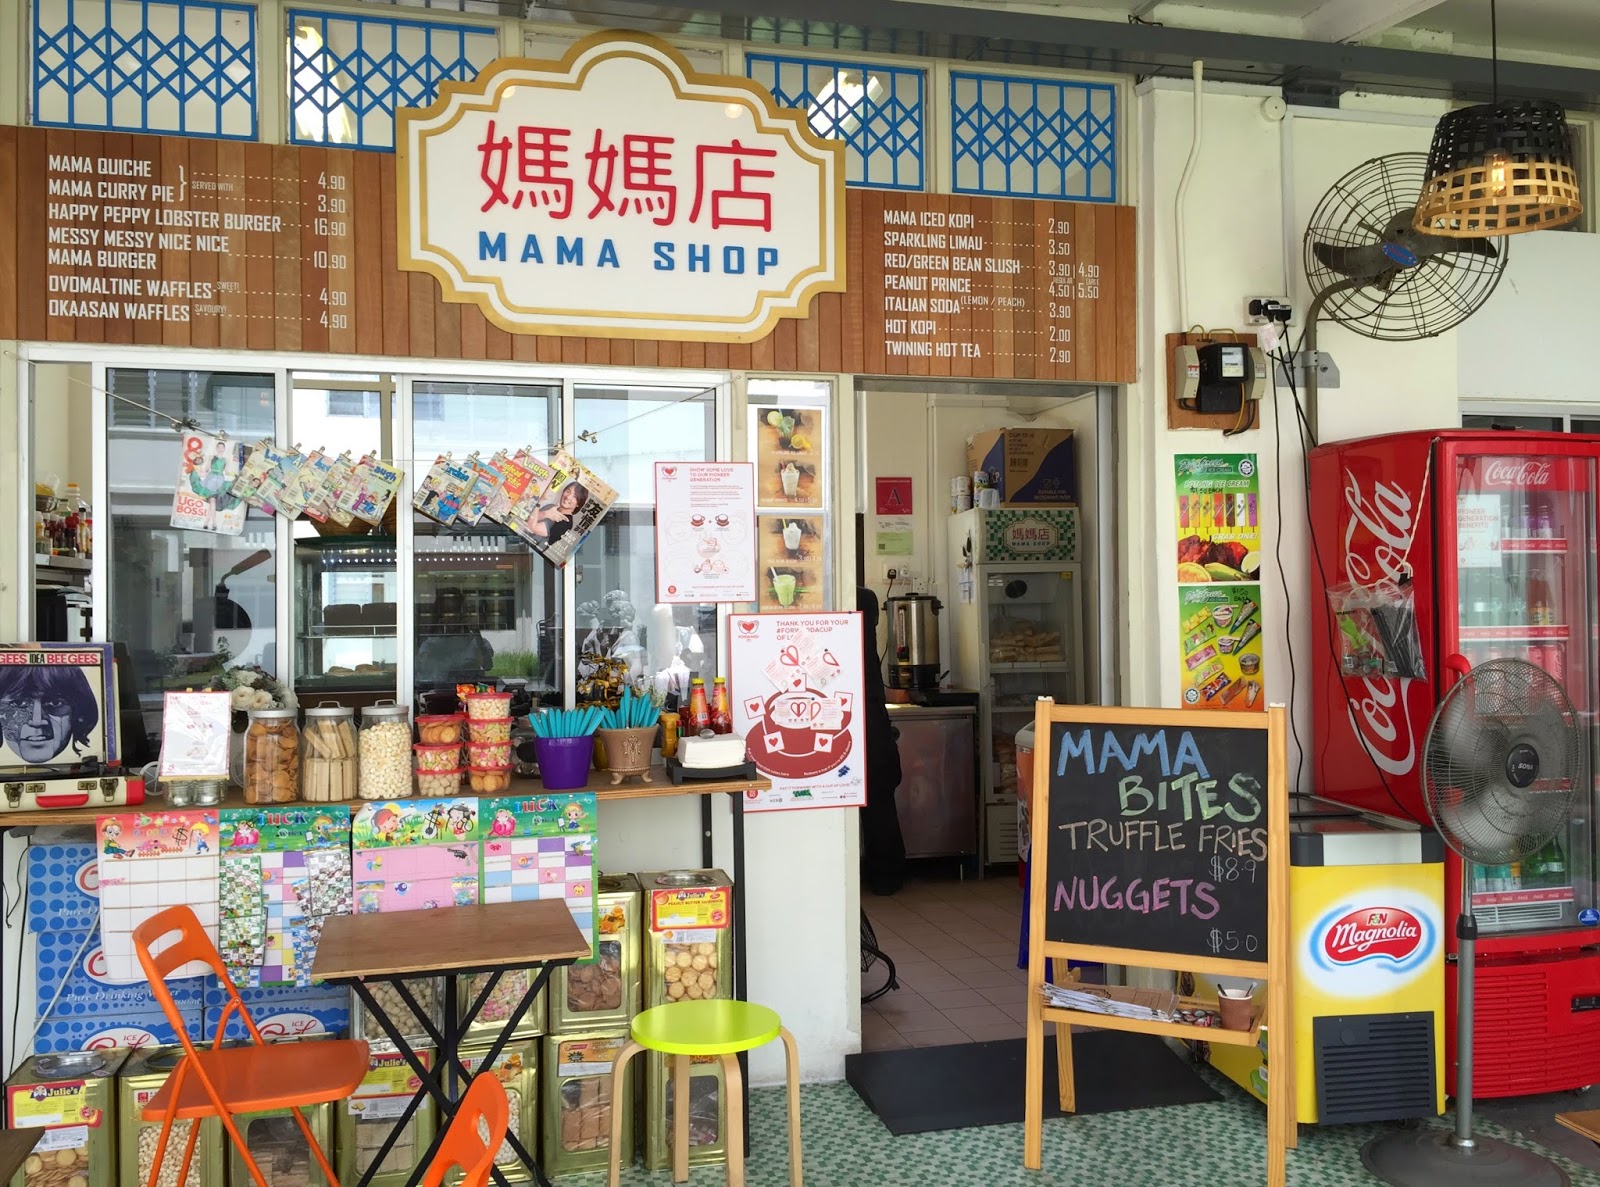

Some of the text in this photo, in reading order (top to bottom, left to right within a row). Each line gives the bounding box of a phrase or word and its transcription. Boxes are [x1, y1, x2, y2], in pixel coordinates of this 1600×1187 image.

[49, 155, 345, 191] MAMA QUICHE 4.90
[477, 120, 777, 232] 媽媽店
[49, 179, 346, 213] MAMA CURRY PIE SERVED WITH 3.90
[49, 203, 346, 237] HAPPY PEPPY LOBSTER BURGER 16.90
[884, 210, 1070, 235] MAMA ICED KOPI 2.90
[49, 227, 229, 253] MESSY MESSY NICE NICE
[884, 231, 1070, 256] SPARKLING LIMAU 3.50
[49, 248, 346, 270] MAMA BURGER 10.90
[479, 231, 779, 275] MAMA SHOP
[884, 253, 1099, 278] RED/GREEN BEAN SLUSH 3.90 4.90
[49, 275, 142, 296] OVOMALTINE
[147, 279, 212, 300] WAFFLES
[319, 291, 347, 306] 4.90
[884, 274, 1099, 299] PEANUT PRINCE 4.50 5.50
[49, 299, 119, 319] OKAASAN
[124, 302, 190, 322] WAFFLES
[319, 311, 347, 329] 4.90
[885, 296, 927, 312] ITALIAN
[930, 299, 960, 314] SODA
[960, 296, 988, 306] (LEMON
[997, 297, 1025, 308] PEACH)
[1049, 302, 1071, 319] 3.90
[885, 319, 1071, 343] HOT KOPI 2.00
[885, 341, 1071, 364] TWINING HOT TEA 2.90
[885, 487, 903, 505] A
[29, 653, 45, 663] IDEA
[1057, 729, 1210, 779] MAMA
[1118, 772, 1262, 823] BITES
[1058, 818, 1268, 862] TRUFFLE FRIES
[1053, 876, 1220, 920] NUGGETS
[1366, 912, 1387, 926] F&N
[1332, 921, 1418, 951] Magnolia
[66, 988, 180, 1002] Pure Drinking Wer
[47, 1087, 79, 1097] Julie's
